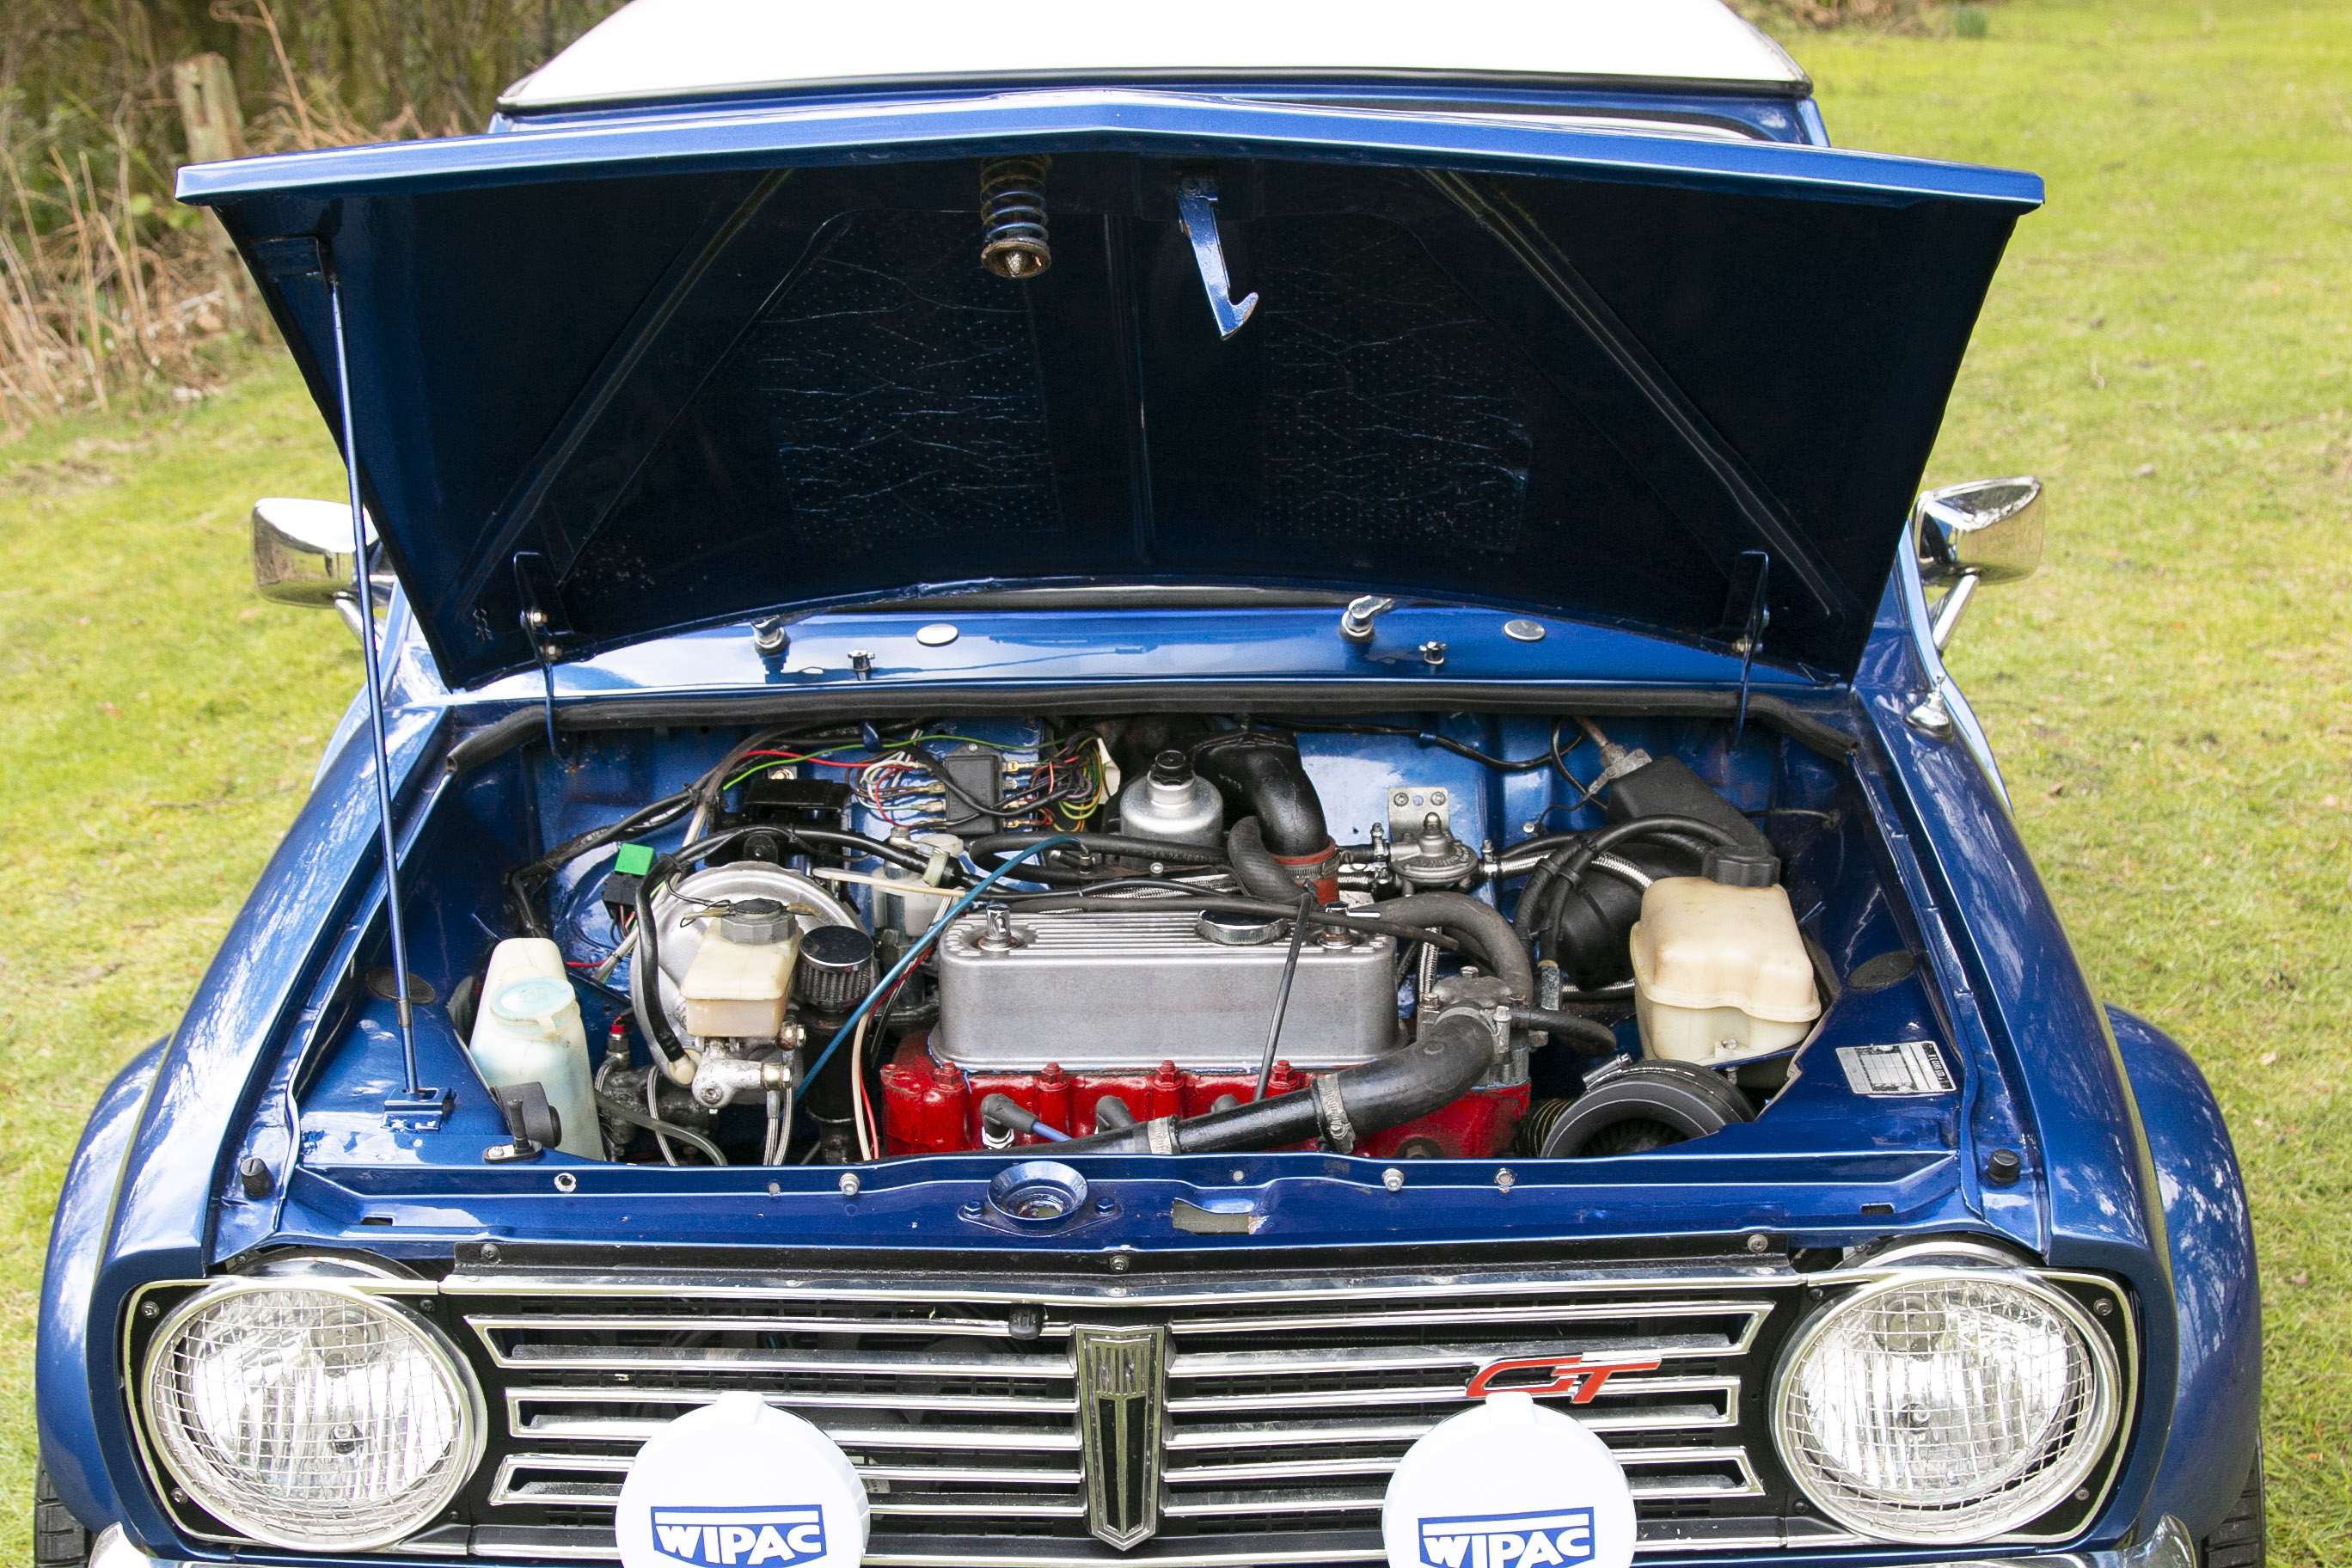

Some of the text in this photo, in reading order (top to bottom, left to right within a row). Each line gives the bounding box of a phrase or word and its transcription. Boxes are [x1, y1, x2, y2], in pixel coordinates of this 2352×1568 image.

[1095, 1346, 1146, 1395] MINI
[1467, 1356, 1662, 1404] GT
[656, 1524, 822, 1565] WIPAC
[1423, 1527, 1590, 1568] WIPAC
